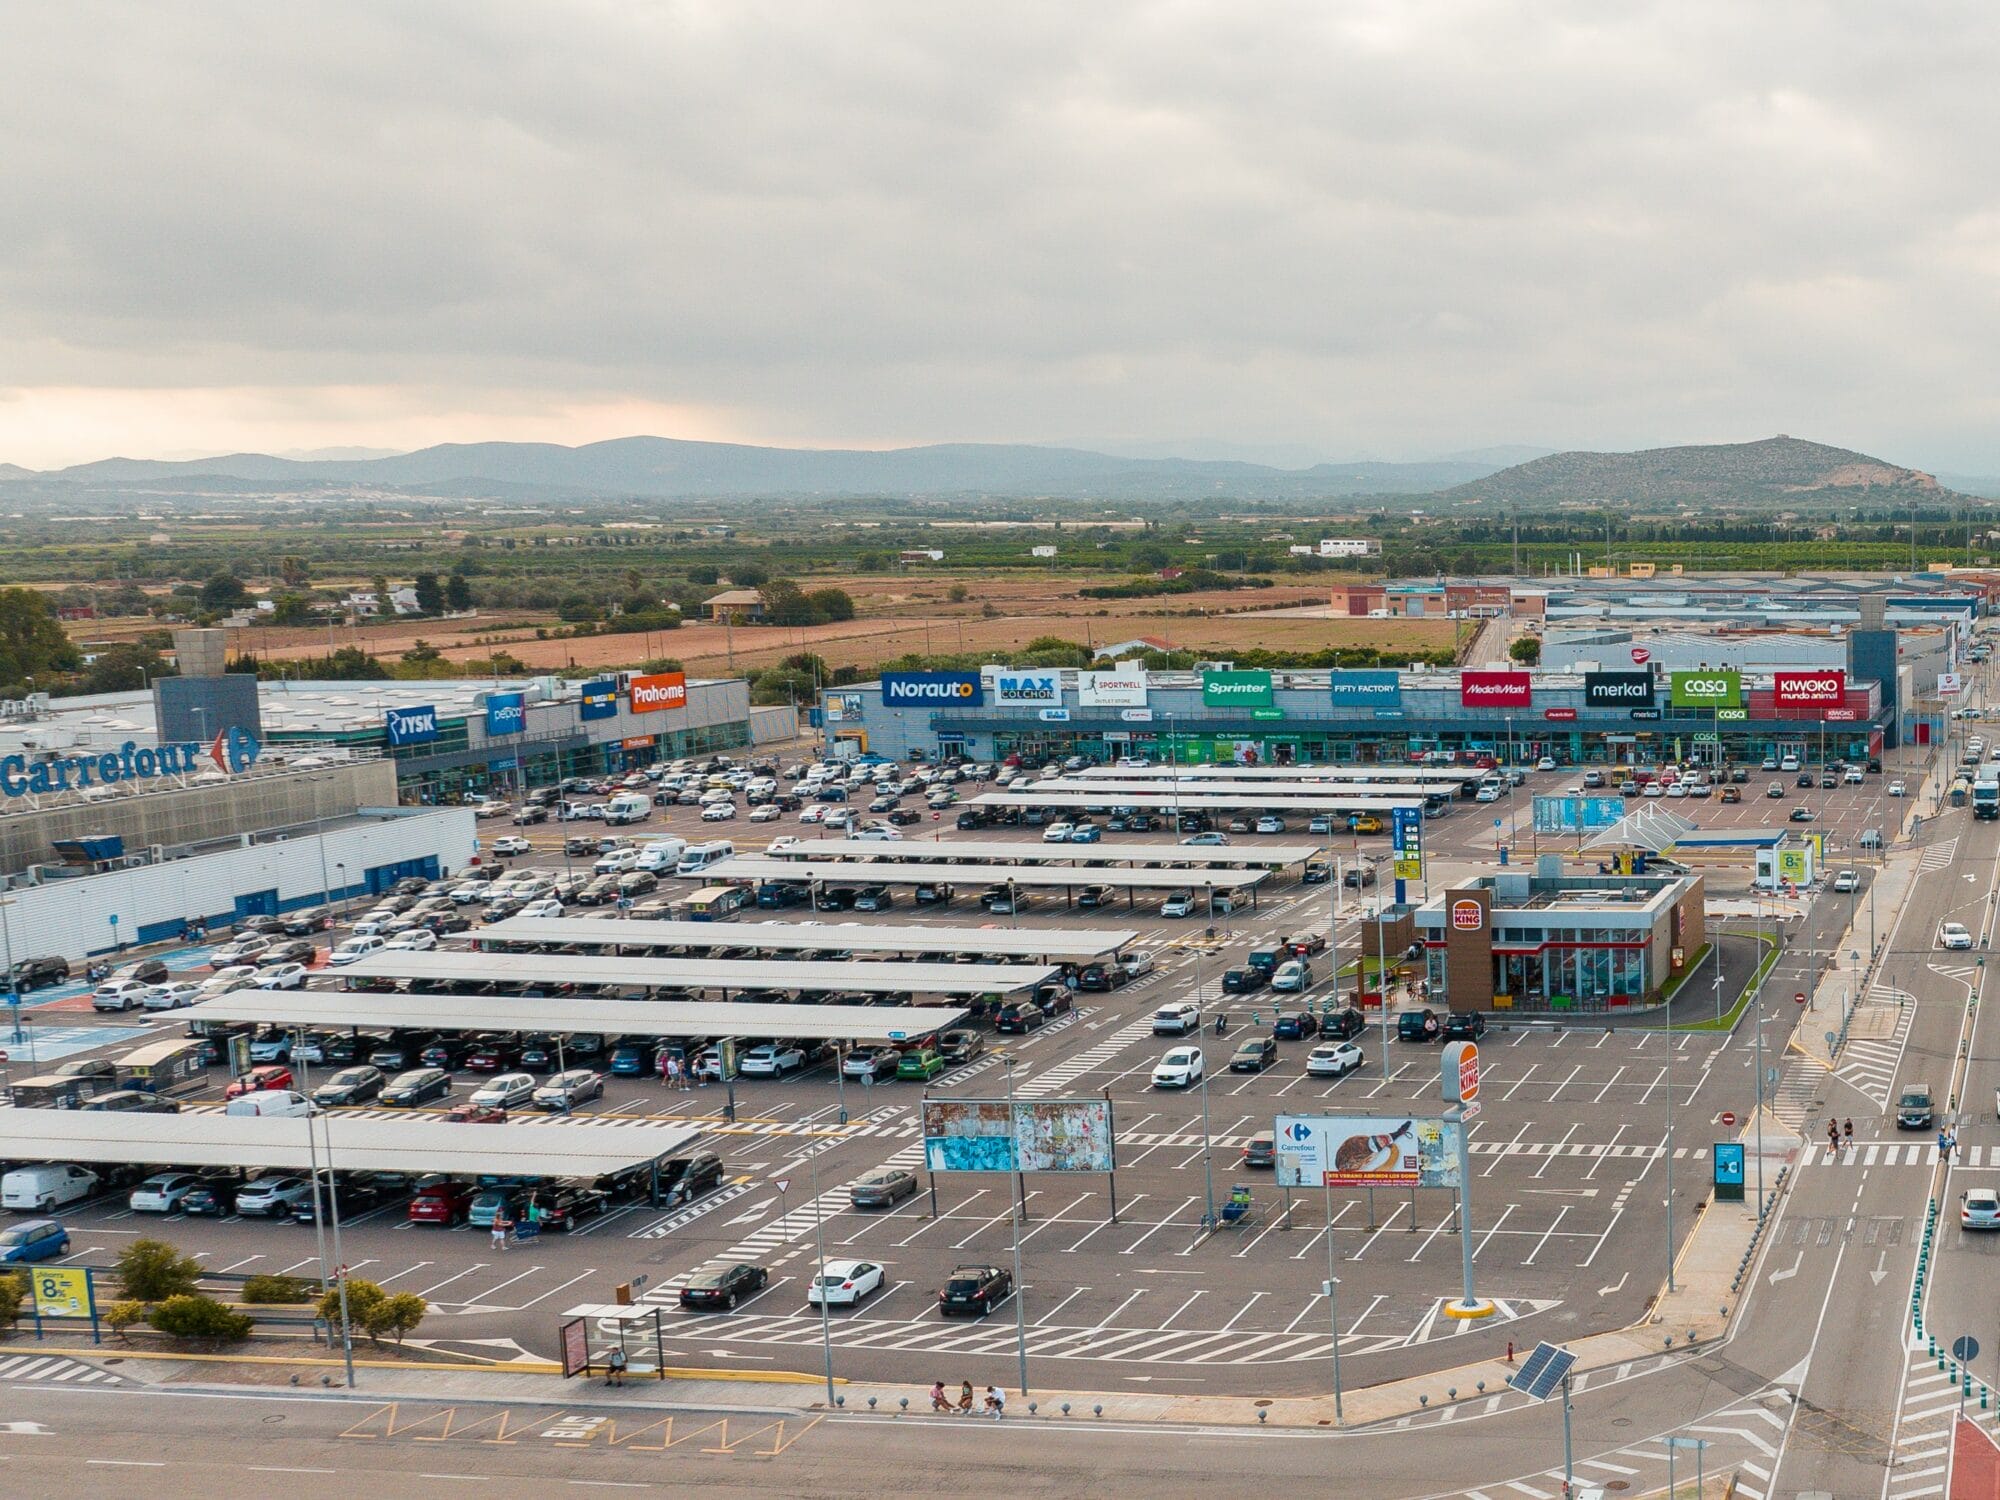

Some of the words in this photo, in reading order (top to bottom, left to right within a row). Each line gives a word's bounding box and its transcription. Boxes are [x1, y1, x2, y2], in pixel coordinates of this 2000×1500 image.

[890, 681, 974, 698] Norauto
[1000, 678, 1053, 690] MAX
[1099, 681, 1142, 690] SPORTWELL
[1208, 682, 1267, 695] Sprinter
[1334, 685, 1357, 693] FIFTY
[1358, 685, 1396, 693] FACTORY
[1593, 682, 1647, 697] merkal
[1684, 680, 1728, 693] casa
[1781, 680, 1838, 692] KIWOKO
[634, 684, 684, 704] Prohome
[1781, 692, 1809, 700] mundo
[1811, 692, 1838, 700] animal
[494, 707, 522, 721] pepco
[1255, 710, 1282, 718] Sprinter
[1633, 711, 1658, 719] merkal
[1718, 710, 1745, 719] casa
[400, 713, 435, 735] JYSK
[0, 741, 200, 798] Carrefour
[1455, 915, 1480, 924] KING
[1460, 1057, 1478, 1076] BURGER
[1460, 1069, 1479, 1092] KING
[540, 1415, 608, 1439] BUS
